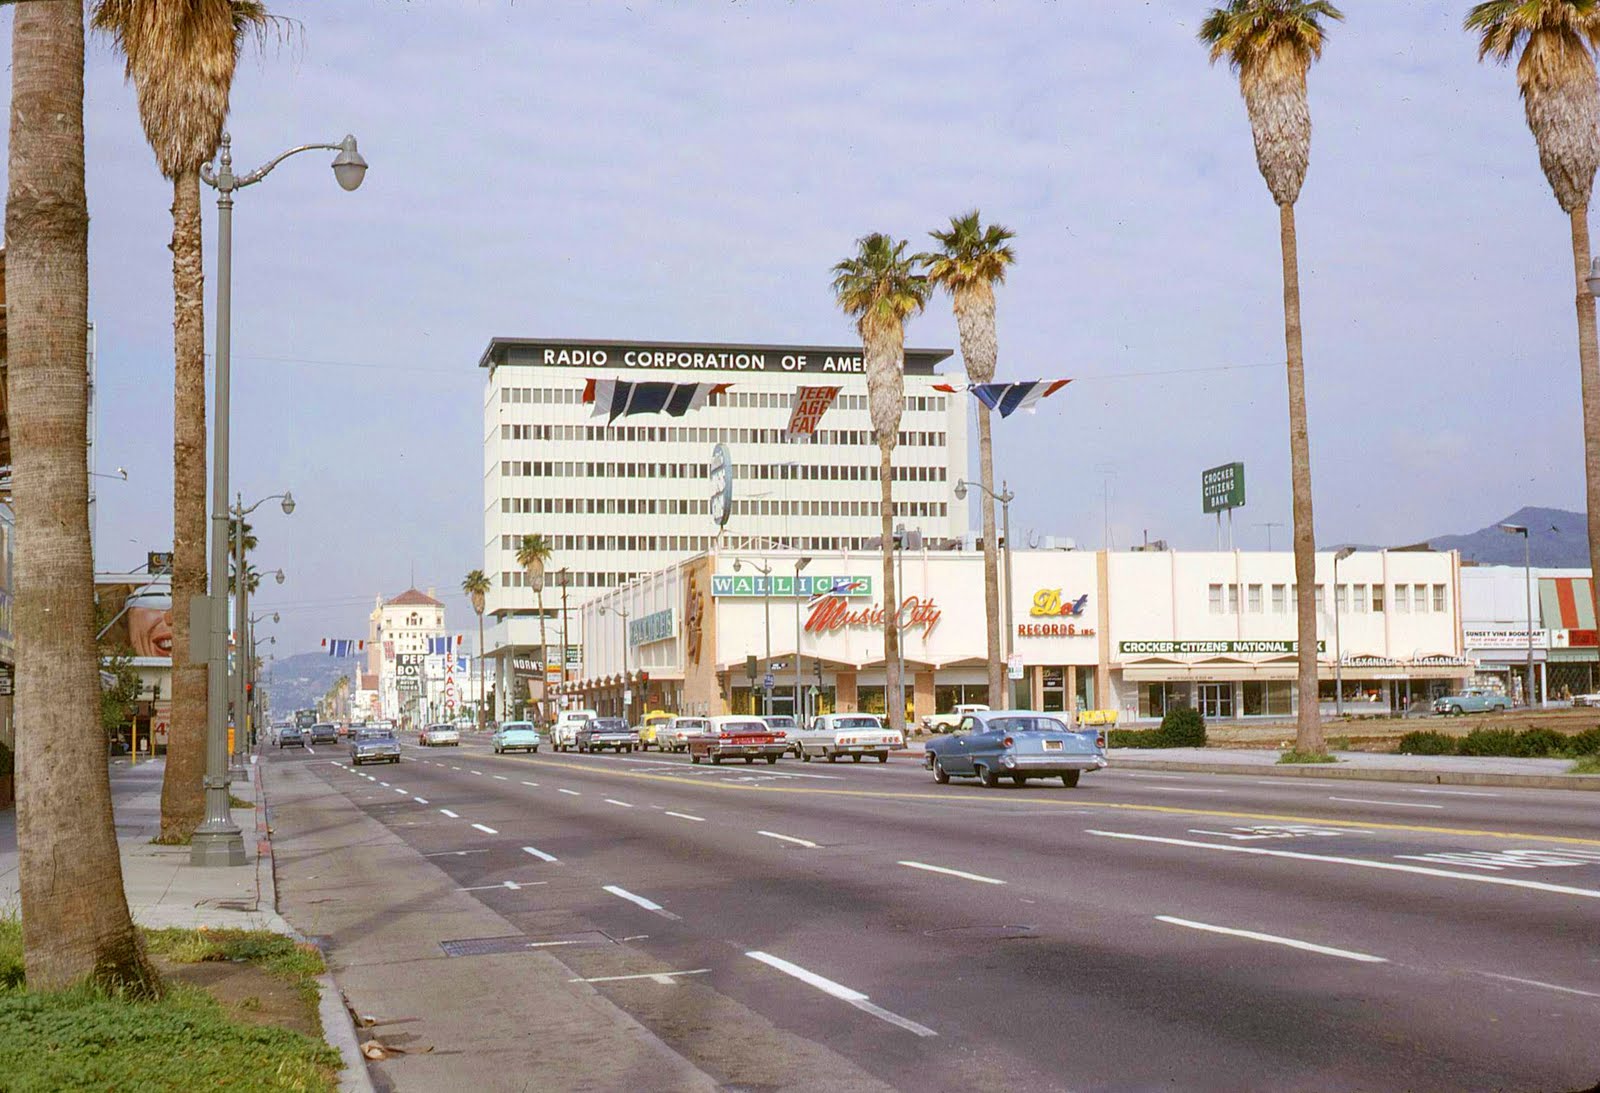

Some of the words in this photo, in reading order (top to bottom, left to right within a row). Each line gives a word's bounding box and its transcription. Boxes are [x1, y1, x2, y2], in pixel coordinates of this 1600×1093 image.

[544, 350, 608, 366] RADIO
[624, 352, 765, 369] CORPORATION
[781, 356, 807, 370] OF
[823, 357, 867, 372] AME
[800, 386, 838, 400] TEEN
[796, 400, 831, 416] AGE
[790, 416, 821, 434] FAI
[1204, 468, 1234, 485] CROCKER
[1204, 480, 1235, 496] CITIZENS
[1211, 494, 1229, 507] BANK
[1030, 588, 1088, 617] Dot
[804, 595, 886, 632] Music
[895, 596, 942, 640] City
[1018, 624, 1075, 637] RECORDS
[1233, 641, 1289, 652] NATIONAL
[1292, 641, 1324, 652] BK
[402, 655, 424, 665] PEP
[513, 658, 544, 672] NORM'S
[446, 652, 455, 709] EXACO
